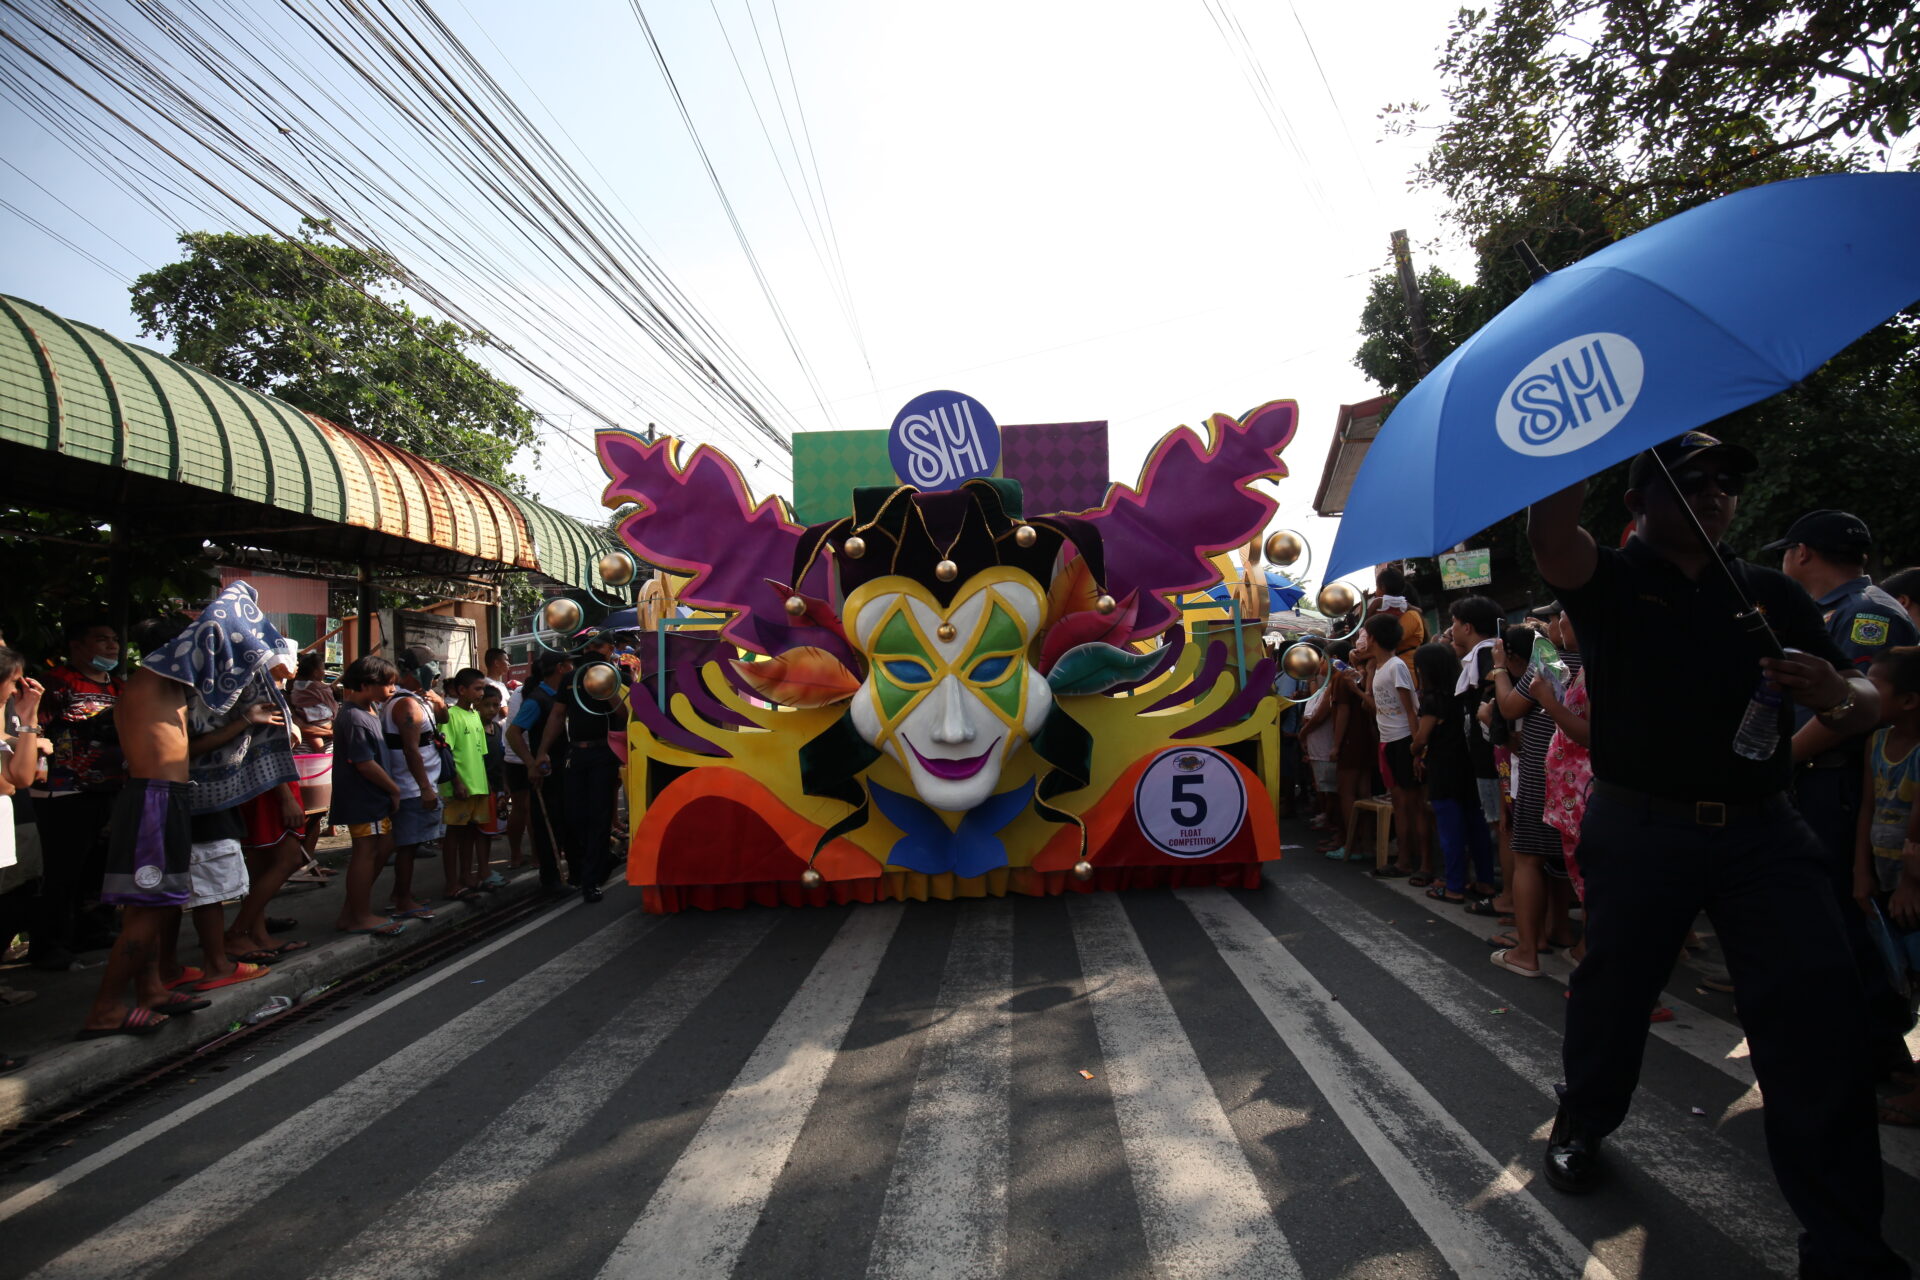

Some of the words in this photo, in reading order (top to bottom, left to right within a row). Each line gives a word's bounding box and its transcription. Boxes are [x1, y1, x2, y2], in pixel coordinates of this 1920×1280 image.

[1511, 339, 1625, 445] SM
[899, 400, 988, 487] SM
[1856, 613, 1890, 622] QUEZON
[1170, 774, 1208, 827] 5
[1168, 837, 1216, 846] COMPETITION
[1180, 829, 1201, 837] FLOAT
